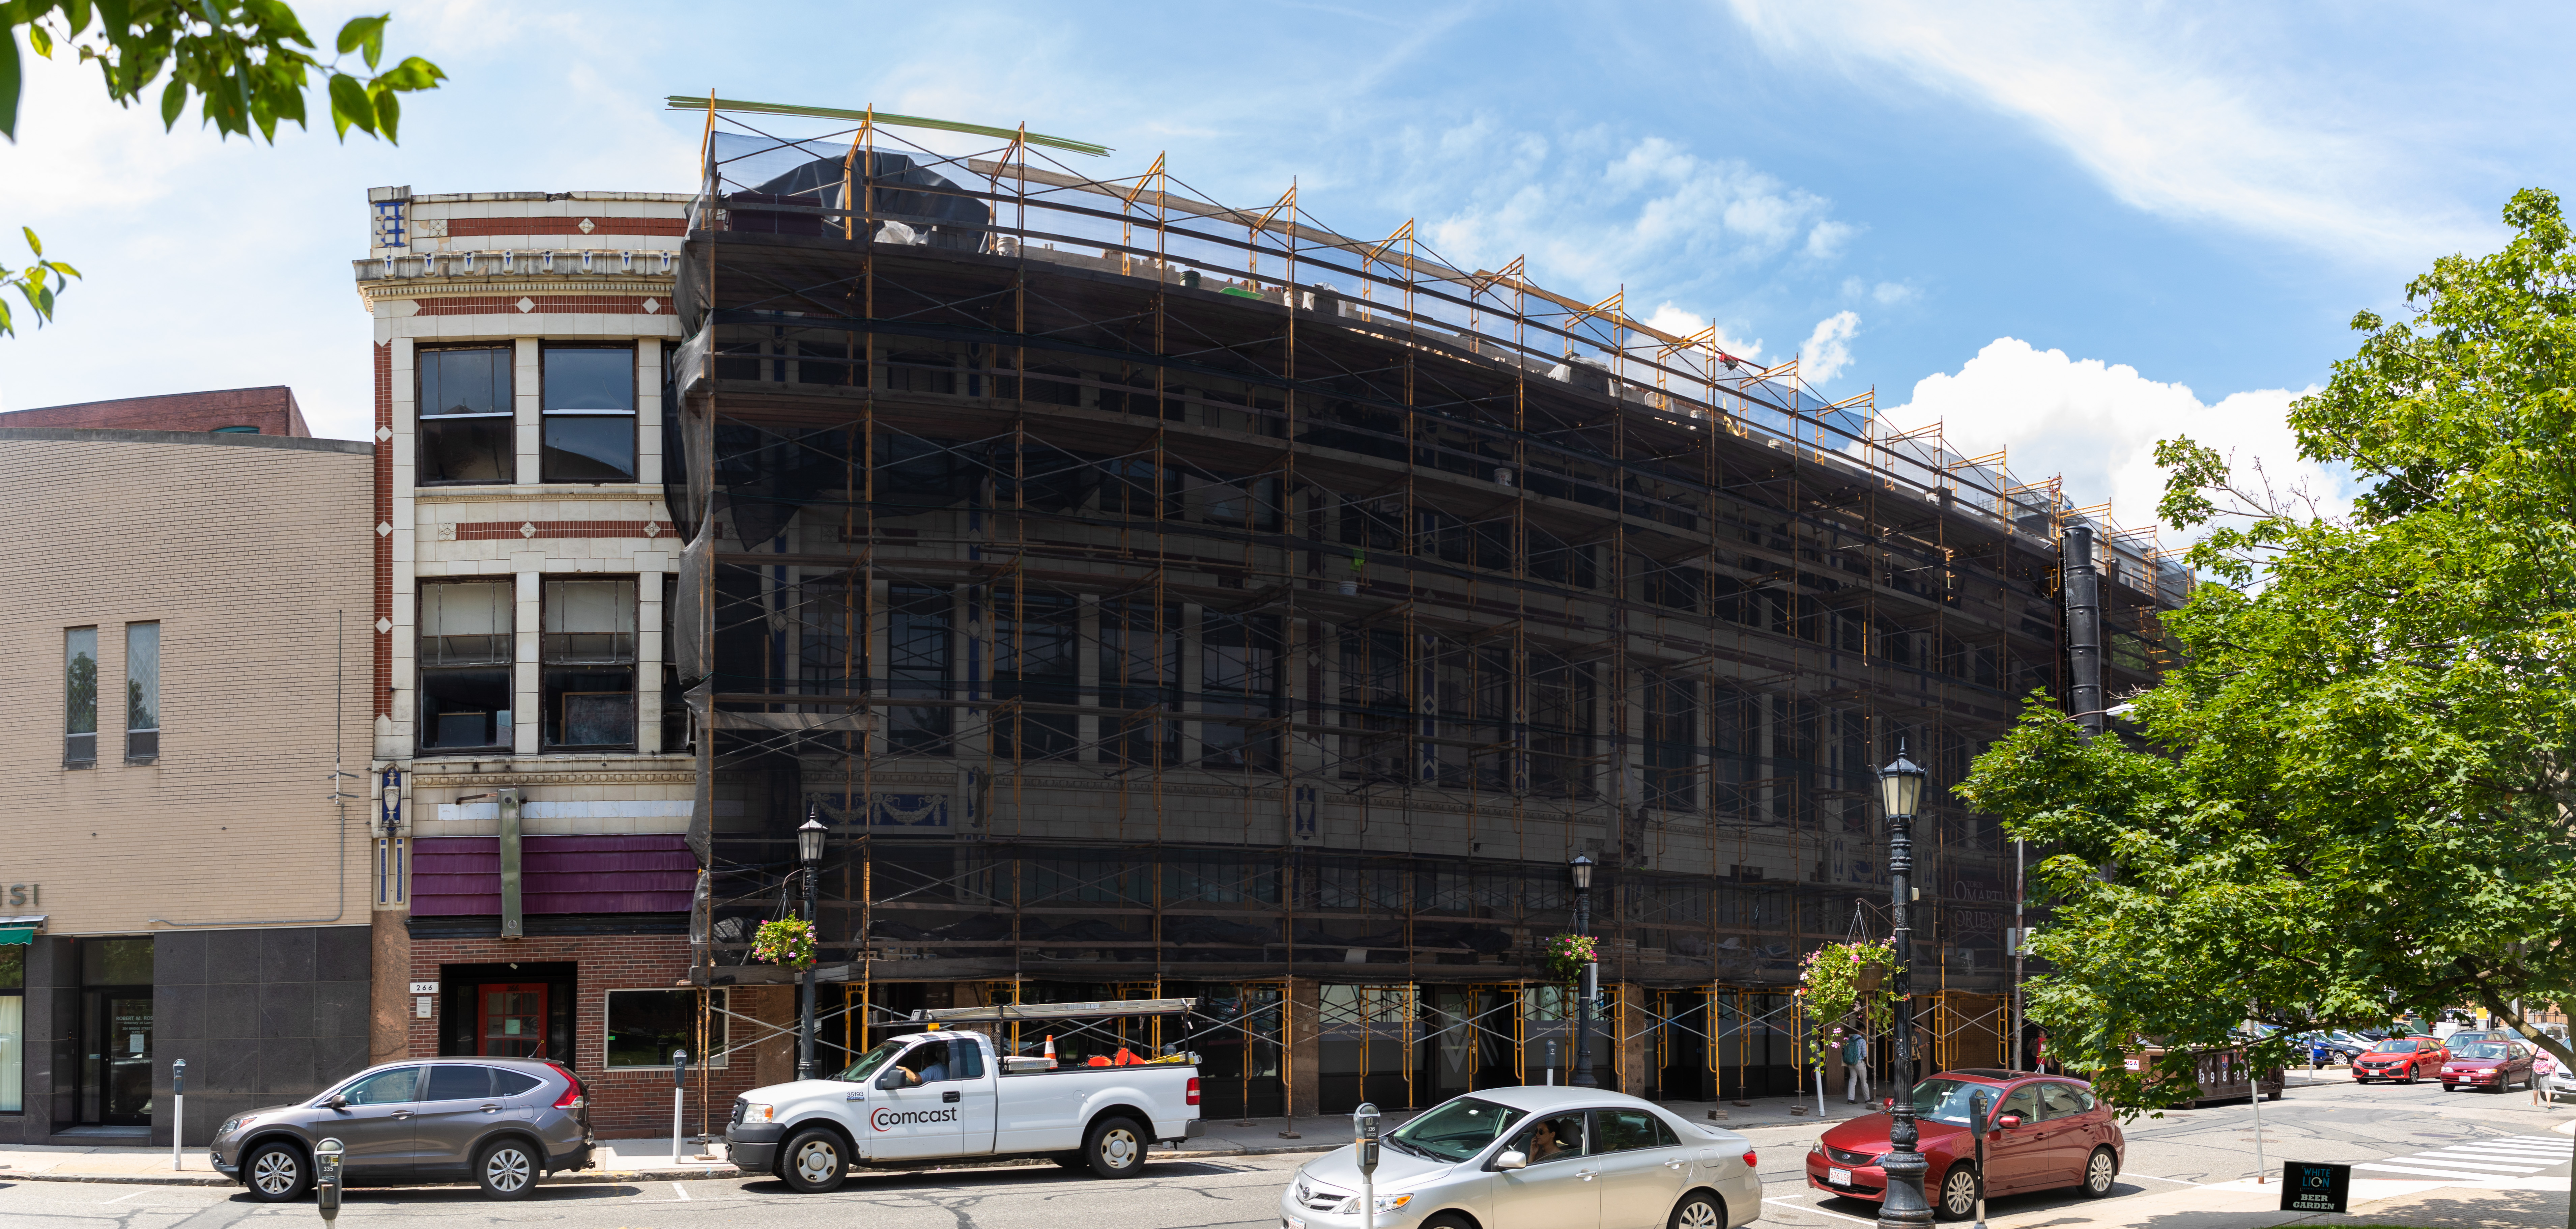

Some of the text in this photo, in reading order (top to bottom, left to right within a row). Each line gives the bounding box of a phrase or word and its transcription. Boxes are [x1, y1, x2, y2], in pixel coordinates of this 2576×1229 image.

[0, 884, 38, 905] SI
[877, 1107, 957, 1126] comcast
[1831, 1171, 1839, 1180] 676
[1840, 1173, 1850, 1182] LS8
[2304, 1168, 2330, 1177] WHITE
[2302, 1176, 2329, 1188] LION
[2293, 1201, 2335, 1210] GARDEN
